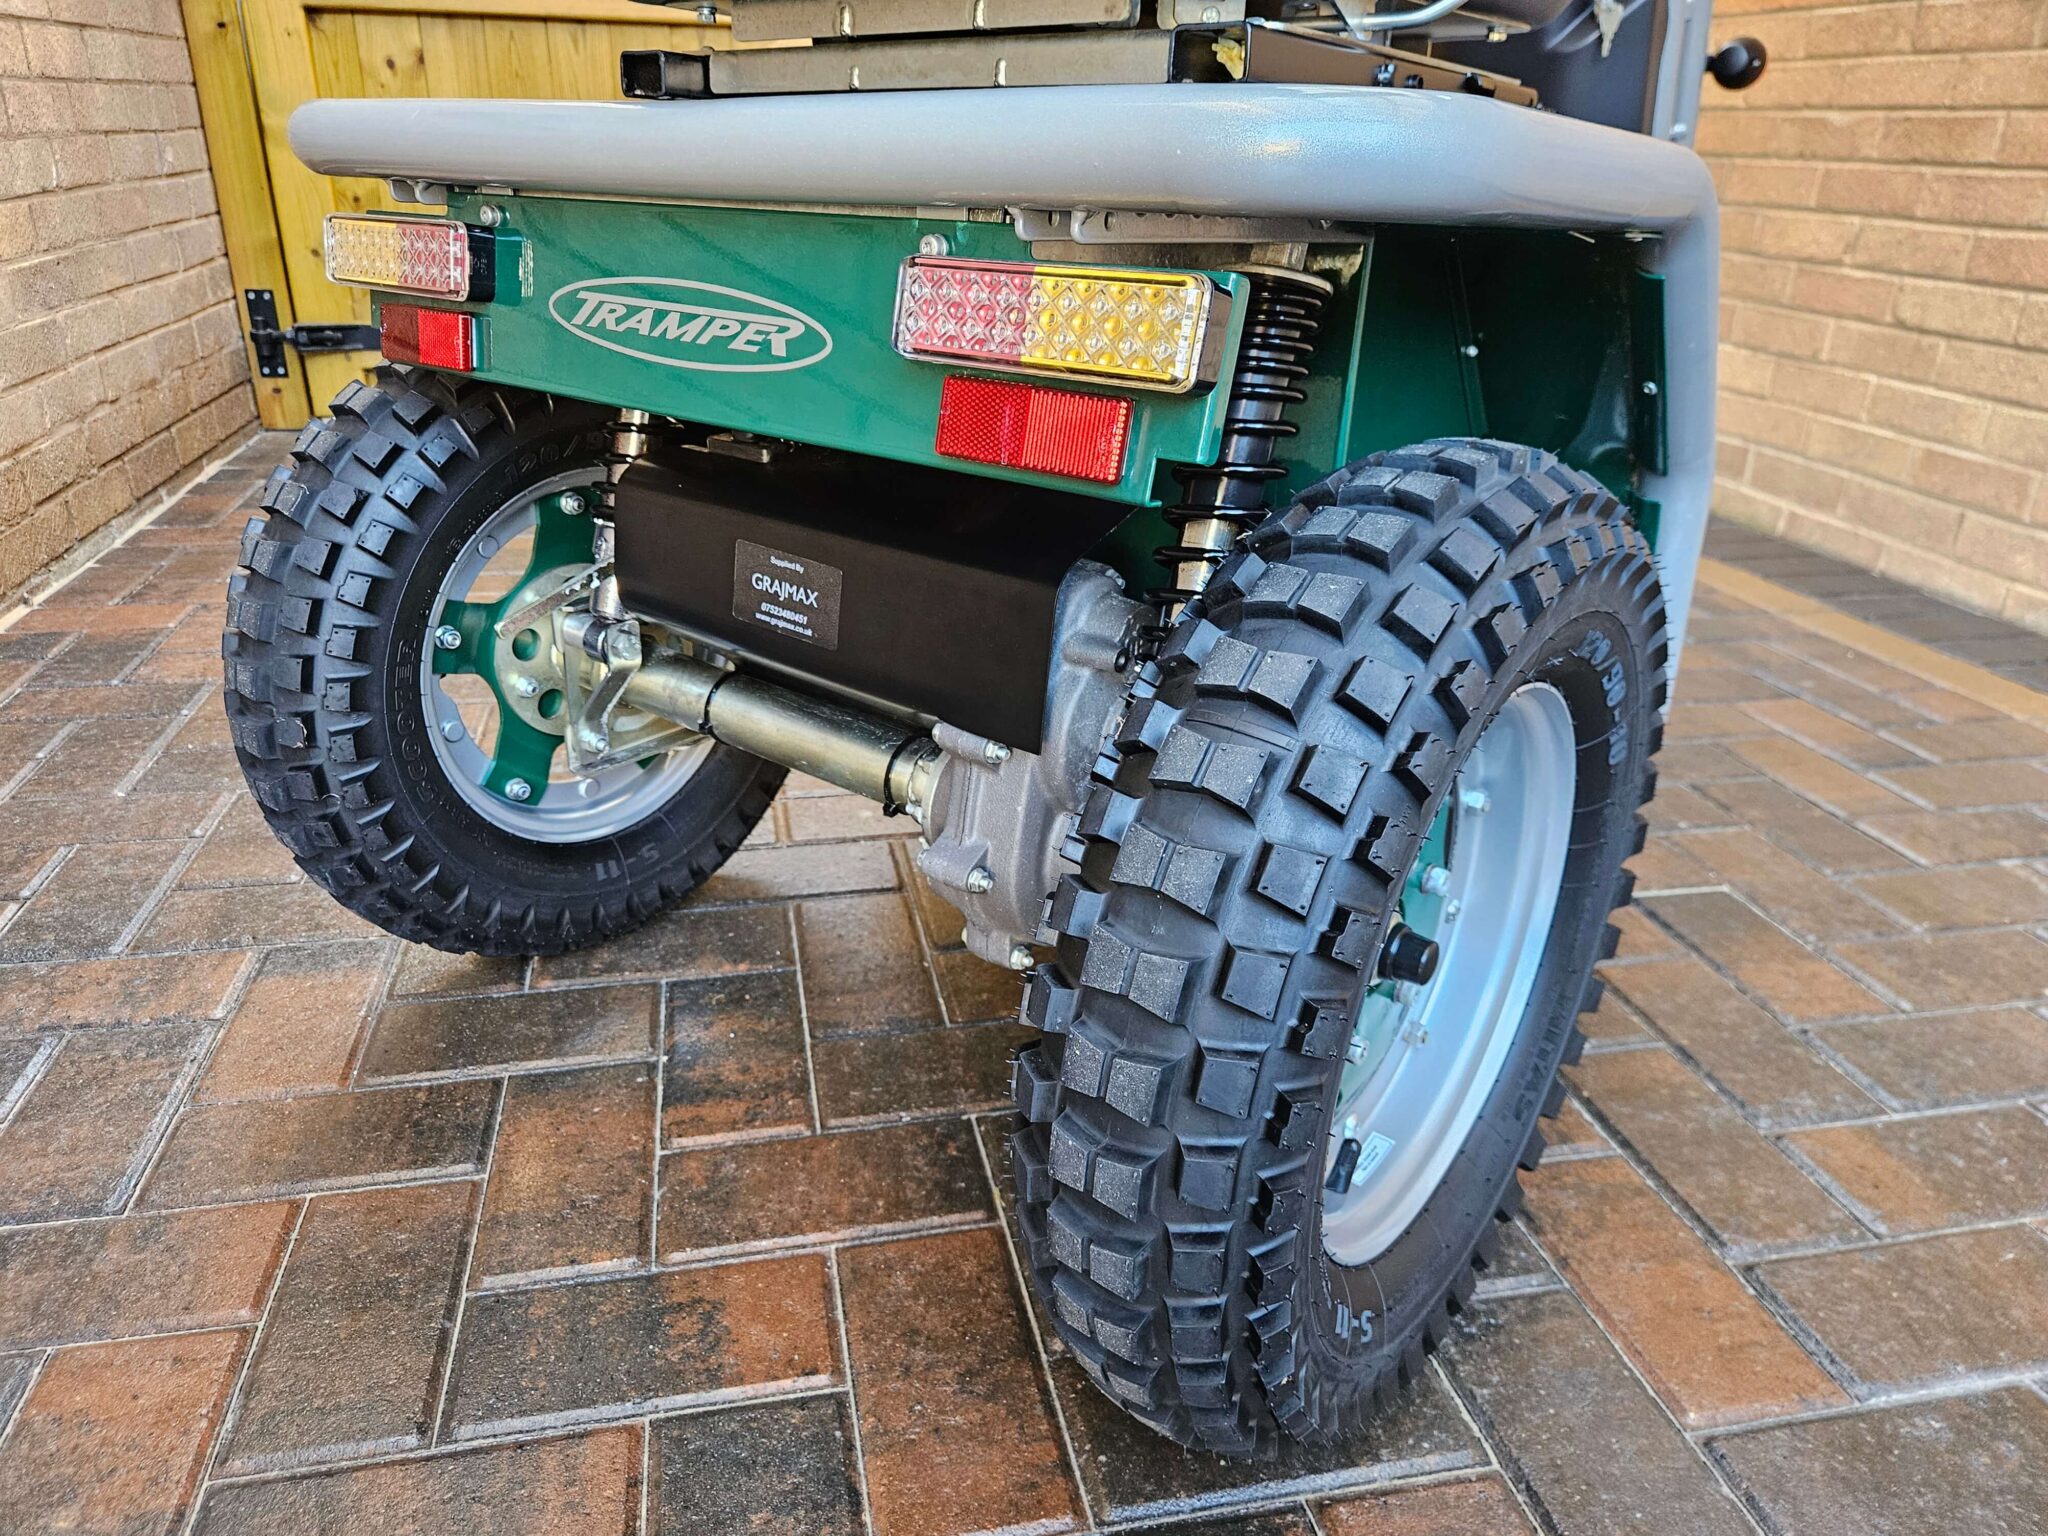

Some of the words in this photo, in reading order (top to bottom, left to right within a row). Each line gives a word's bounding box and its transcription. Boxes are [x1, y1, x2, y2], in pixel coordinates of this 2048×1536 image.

[570, 290, 806, 357] TRAMPER
[770, 556, 795, 569] Supplied
[796, 563, 804, 574] By
[752, 573, 818, 608] GRAJMAX
[755, 612, 813, 636] www.grajmax.co.uk
[761, 602, 808, 625] 07523480451
